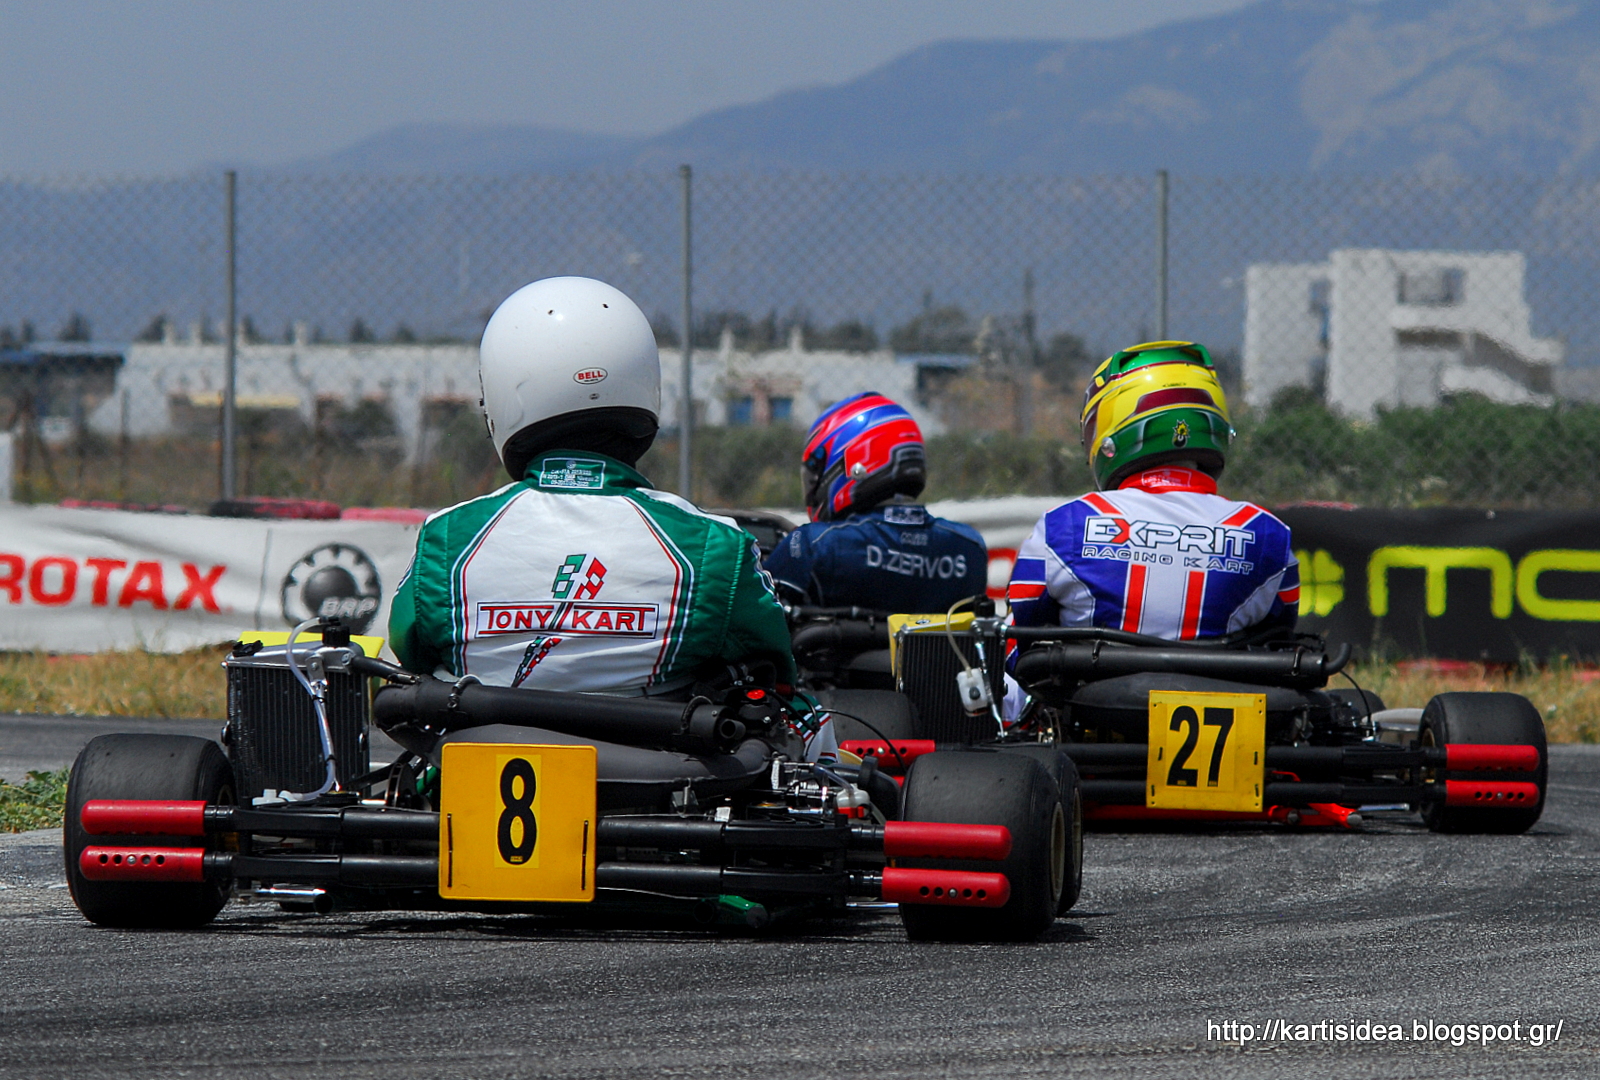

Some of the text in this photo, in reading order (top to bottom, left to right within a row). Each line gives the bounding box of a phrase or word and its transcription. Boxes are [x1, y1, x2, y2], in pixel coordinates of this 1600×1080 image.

[577, 370, 604, 380] BELL
[1083, 515, 1255, 558] EXPRIT
[866, 544, 967, 579] D.ZERVOS
[1082, 545, 1254, 573] RACING KART
[0, 552, 228, 615] ROTAX
[319, 596, 378, 619] BRP
[479, 605, 655, 632] TONY KART
[1166, 705, 1235, 787] 27
[497, 757, 538, 866] 8
